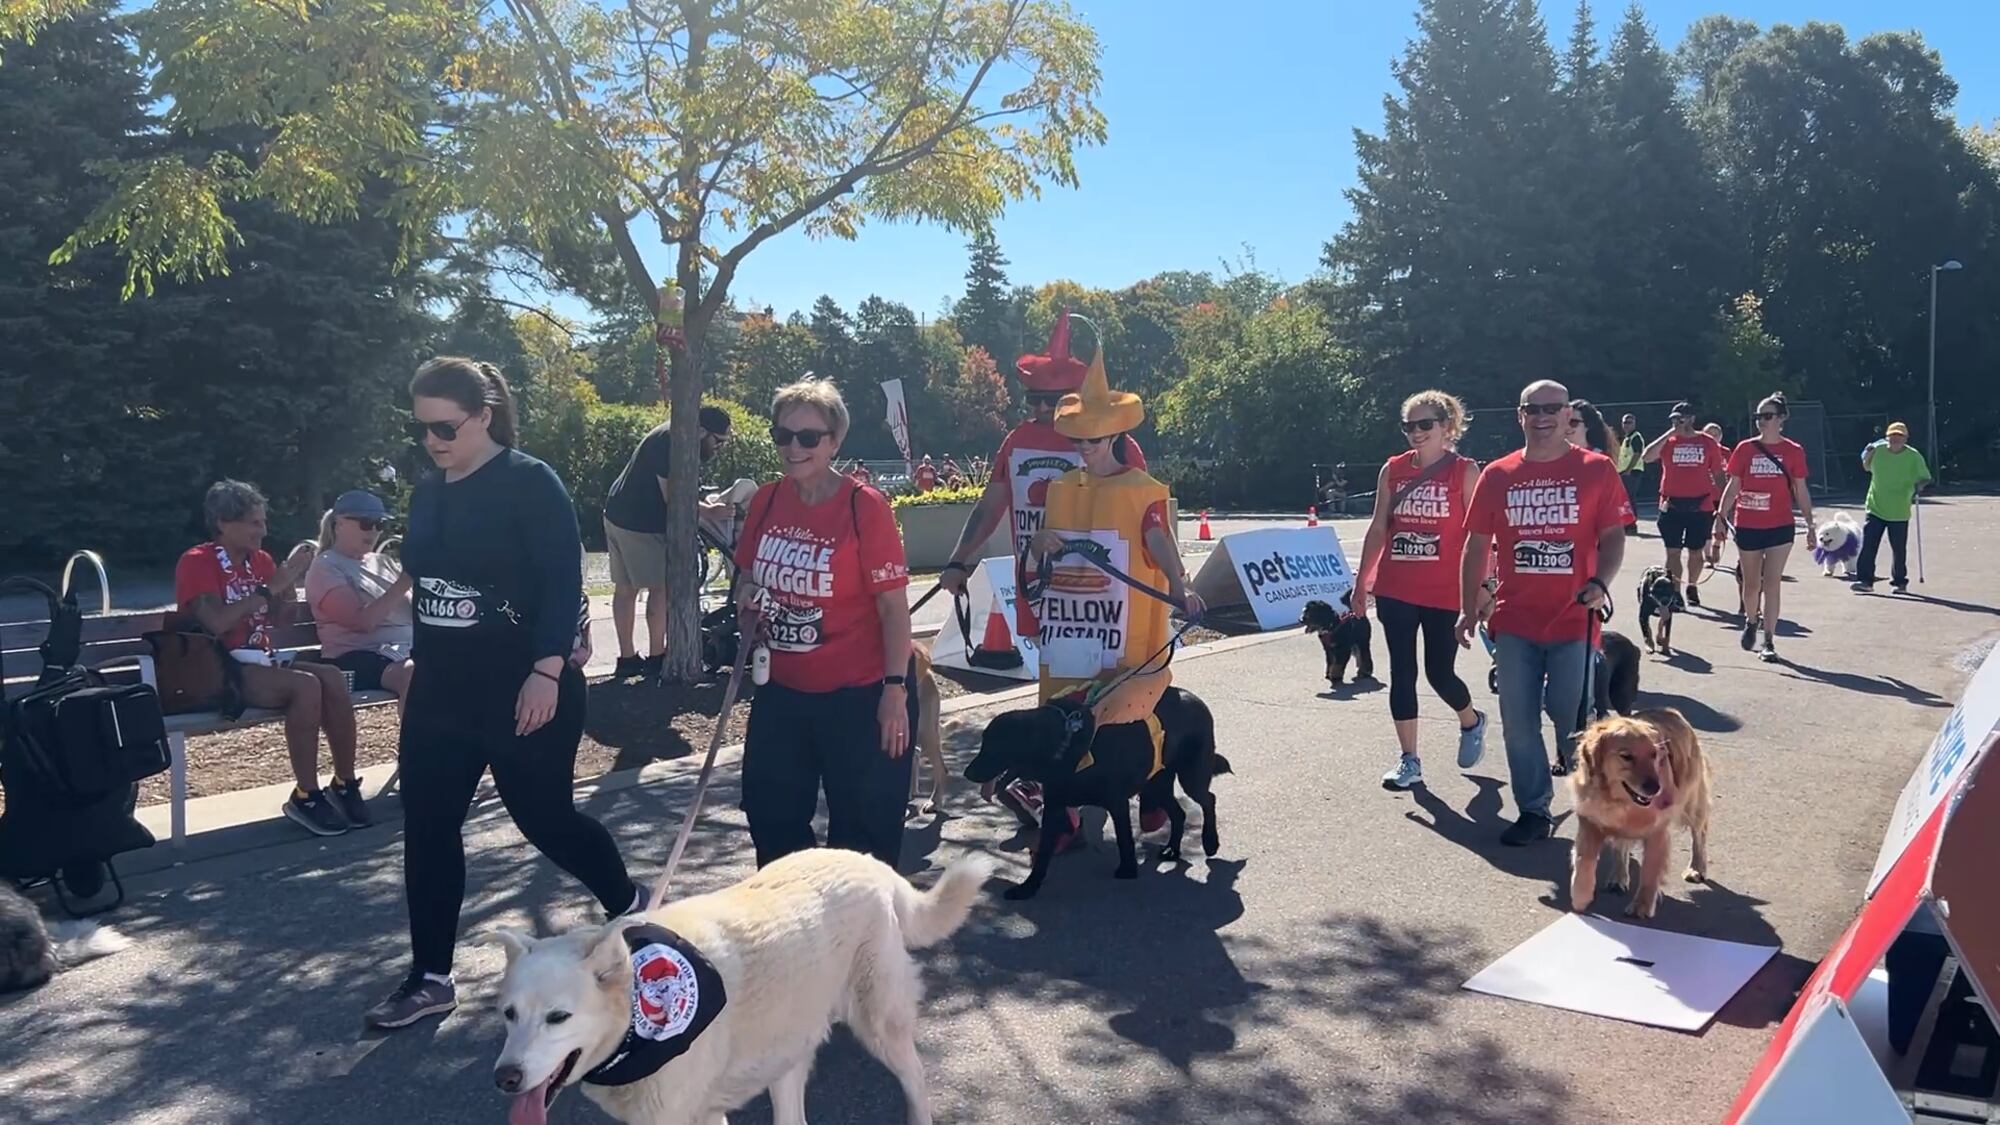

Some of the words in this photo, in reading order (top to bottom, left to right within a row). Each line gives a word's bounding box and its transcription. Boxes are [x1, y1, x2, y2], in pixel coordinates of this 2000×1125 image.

[1507, 486, 1577, 508] WIGGLE
[1504, 504, 1580, 527] WAGGLE
[1544, 525, 1566, 534] lives
[756, 533, 835, 573] WIGGLE
[1531, 554, 1558, 567] 1130
[1242, 551, 1344, 597] petsecure
[1038, 597, 1123, 624] YELLOW
